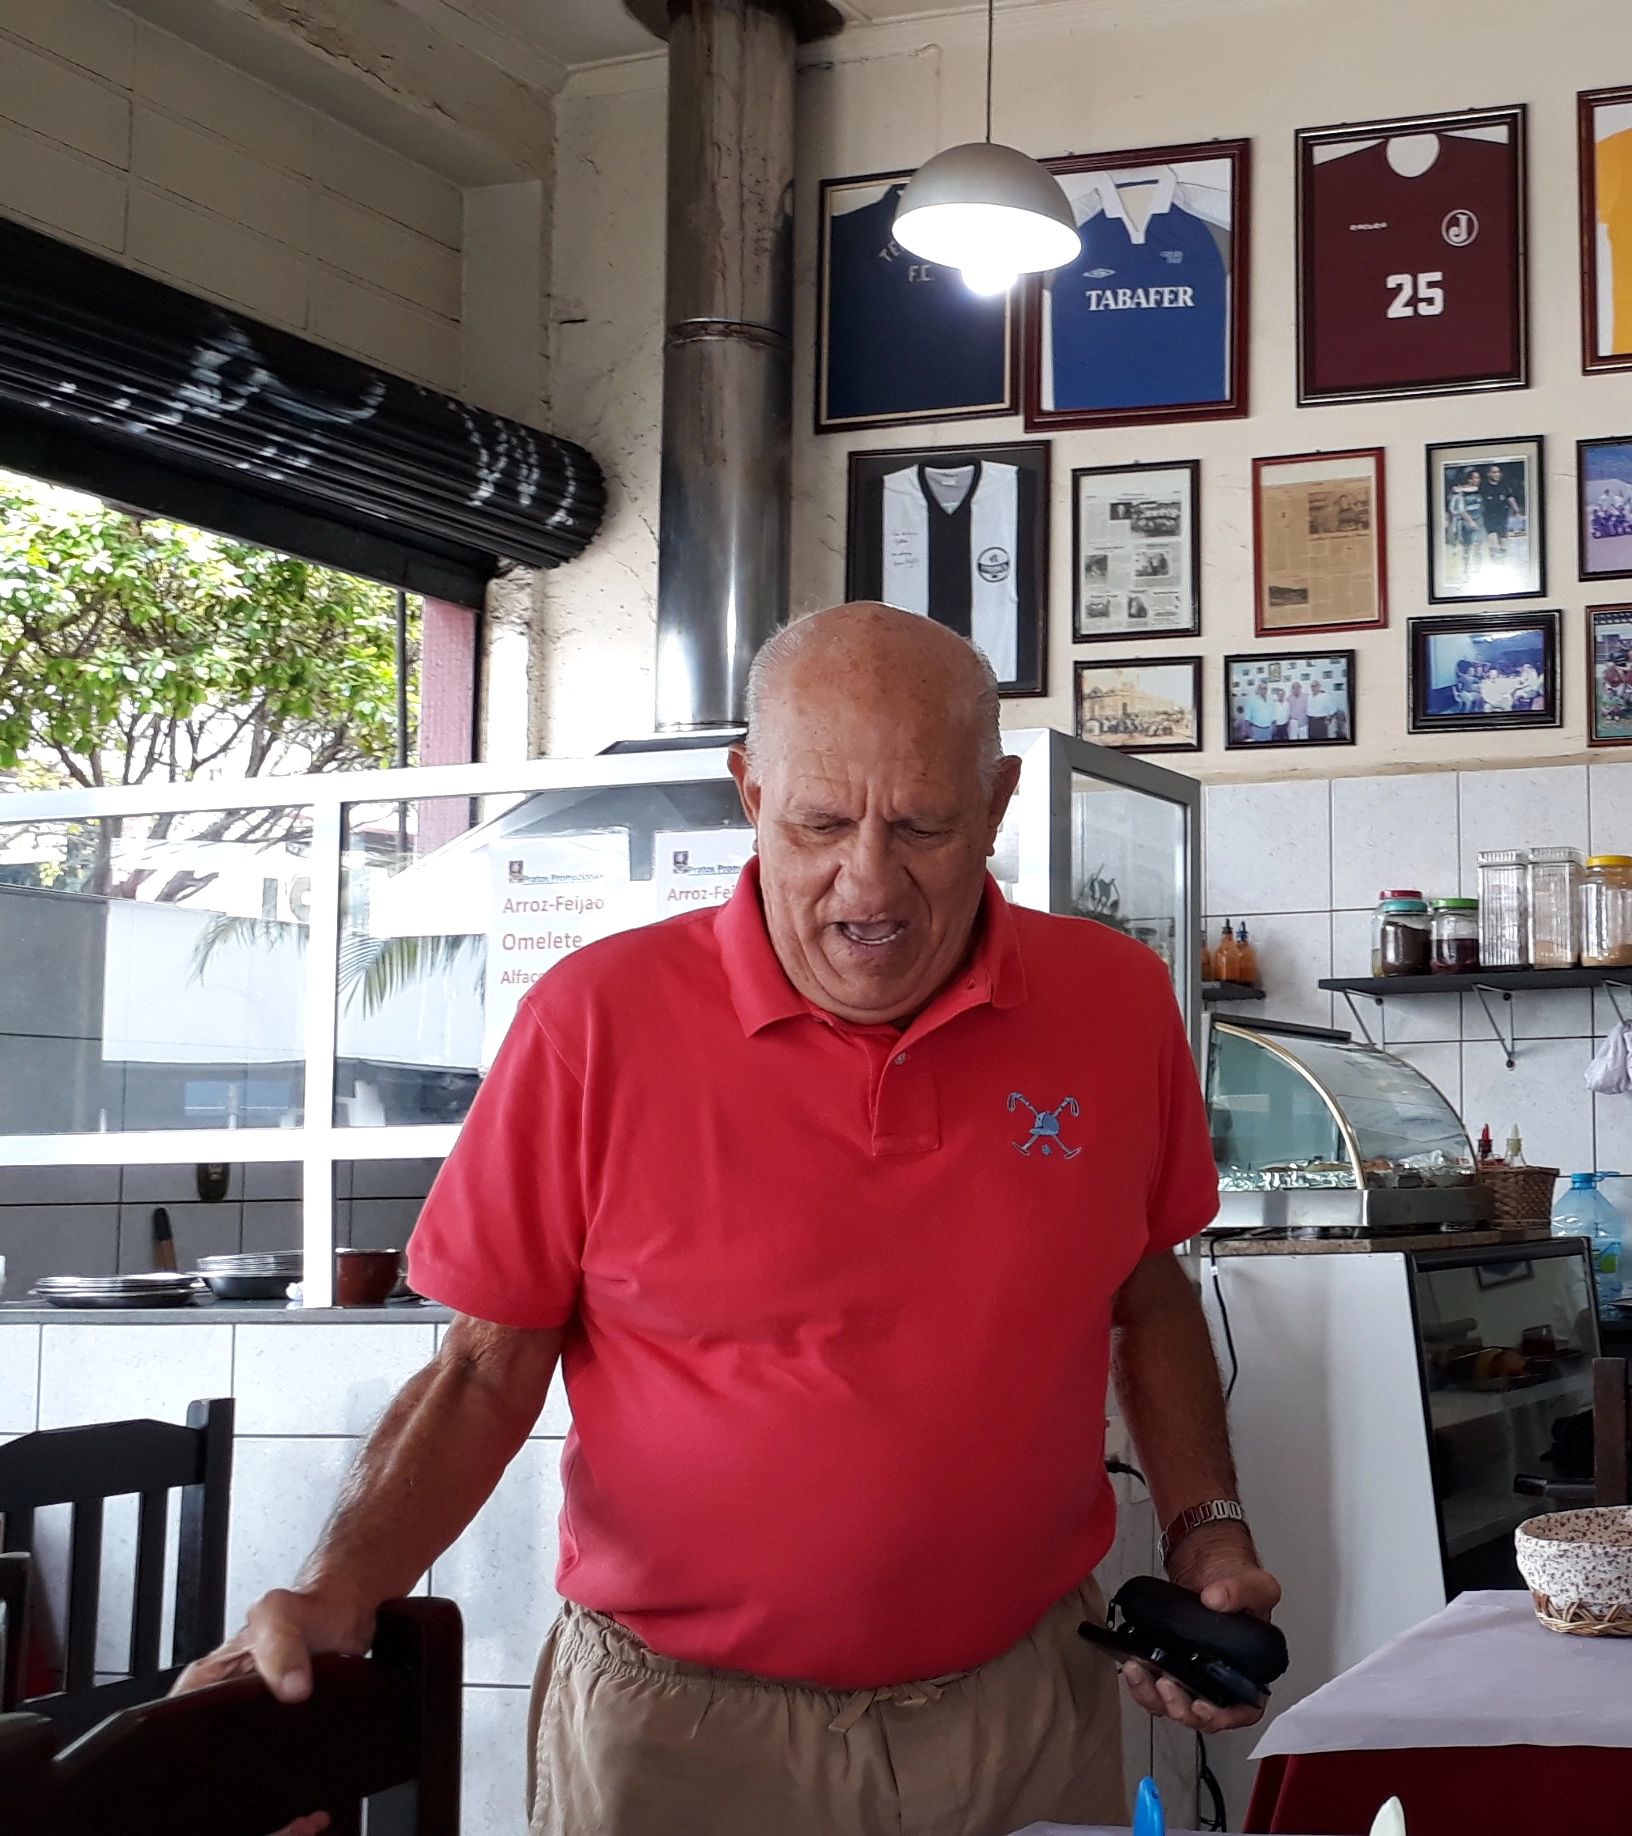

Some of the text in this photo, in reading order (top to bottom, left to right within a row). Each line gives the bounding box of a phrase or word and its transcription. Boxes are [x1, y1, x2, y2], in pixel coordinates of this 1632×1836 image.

[1085, 286, 1195, 311] TABAFER
[1386, 271, 1444, 319] 25
[667, 885, 736, 902] Arroz-Fei
[502, 931, 582, 950] Omelete
[500, 969, 545, 985] Alfac
